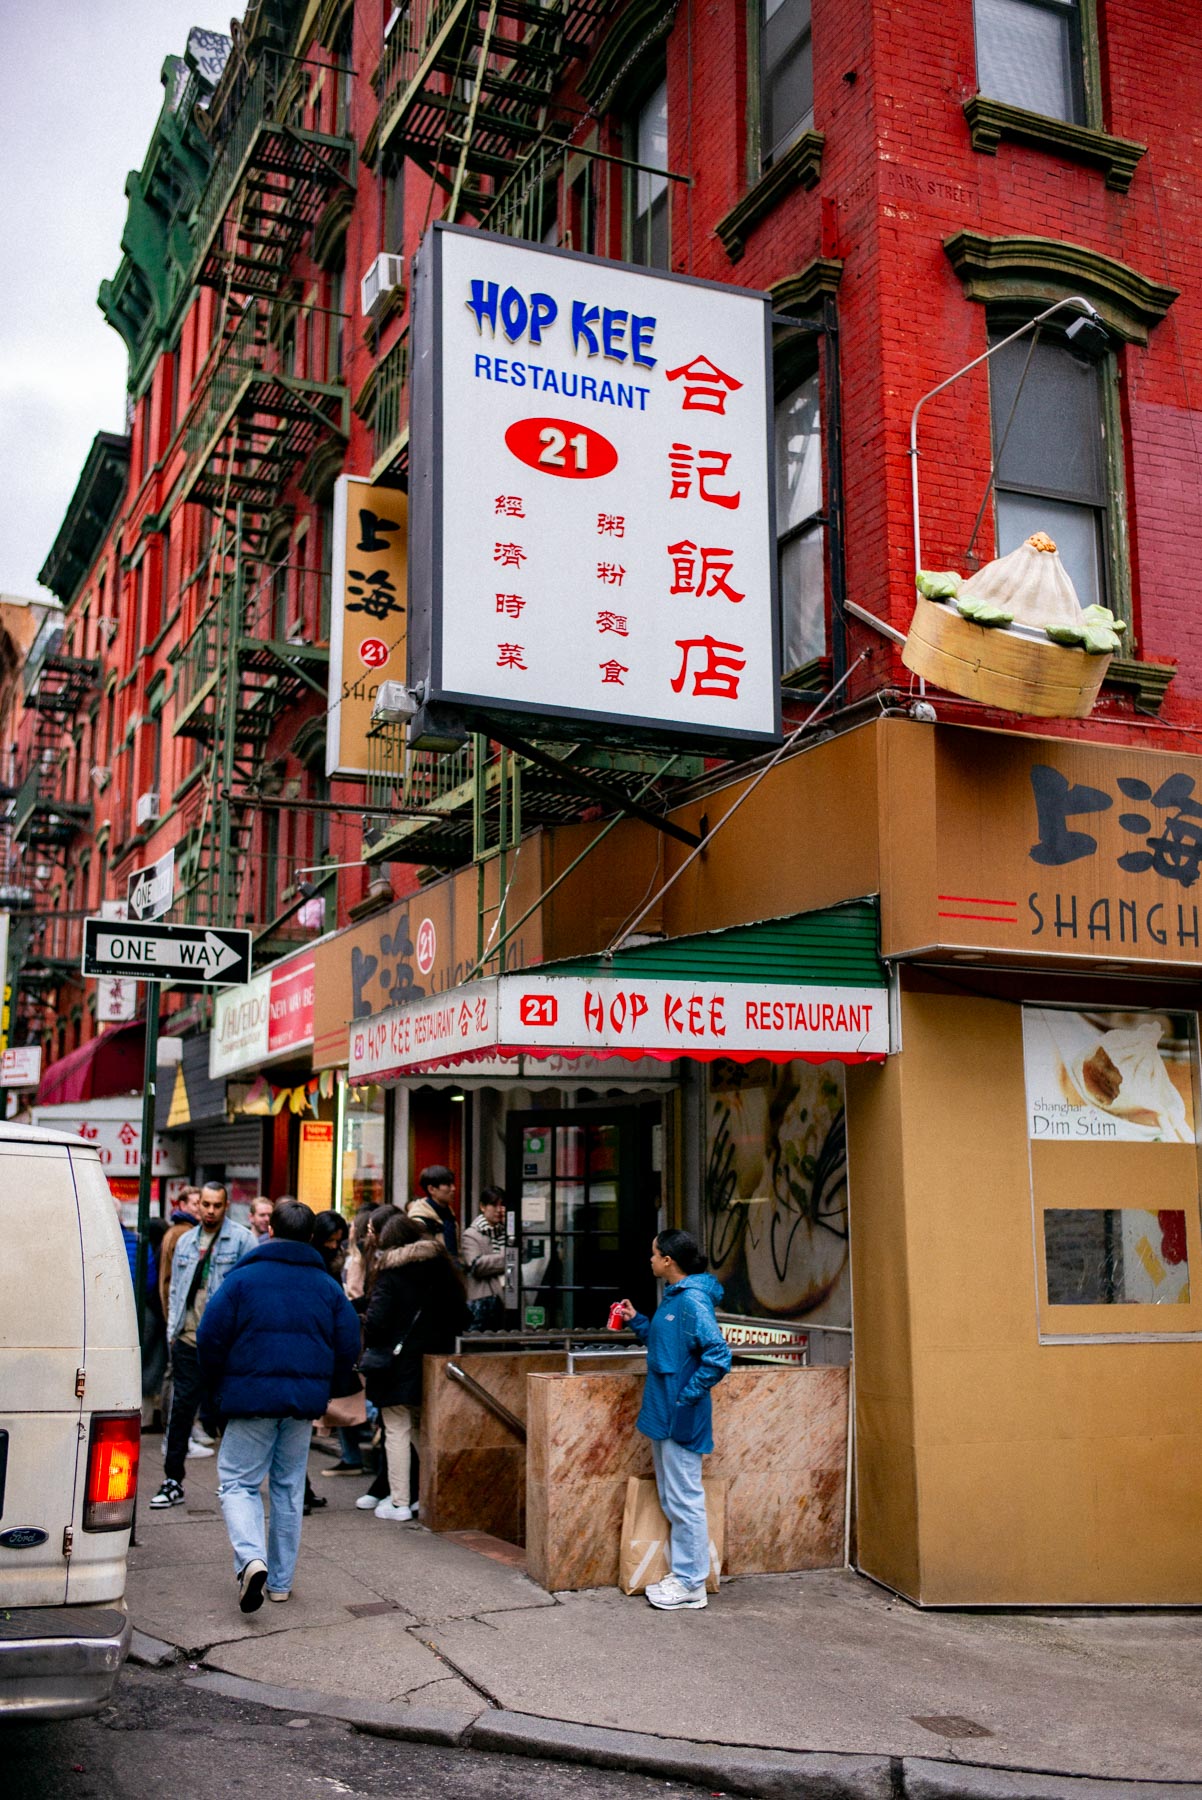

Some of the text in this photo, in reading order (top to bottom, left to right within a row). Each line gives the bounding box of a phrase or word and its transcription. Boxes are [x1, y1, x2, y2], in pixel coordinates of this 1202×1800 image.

[927, 180, 974, 207] STREET
[465, 279, 658, 370] HOP KEE
[475, 354, 651, 411] RESTAURANT
[538, 426, 589, 470] 21
[665, 354, 747, 699] 合記飯店
[345, 508, 405, 621] 上海
[493, 495, 528, 671] 經濟時菜
[595, 512, 630, 686] 粥粉麵食
[361, 643, 385, 662] 21
[1028, 764, 1202, 888] 上海
[136, 884, 153, 907] ONE
[110, 938, 226, 967] ONE WAY
[419, 929, 434, 962] 21
[368, 1024, 387, 1061] HOP
[391, 1017, 411, 1056] KEE
[414, 1007, 455, 1045] RESTAURANT
[458, 996, 489, 1037] 合記
[525, 990, 873, 1038] 21 HOP KEE RESTAURANT
[1033, 1096, 1082, 1117] Shanghai
[9, 1530, 37, 1543] Ford
